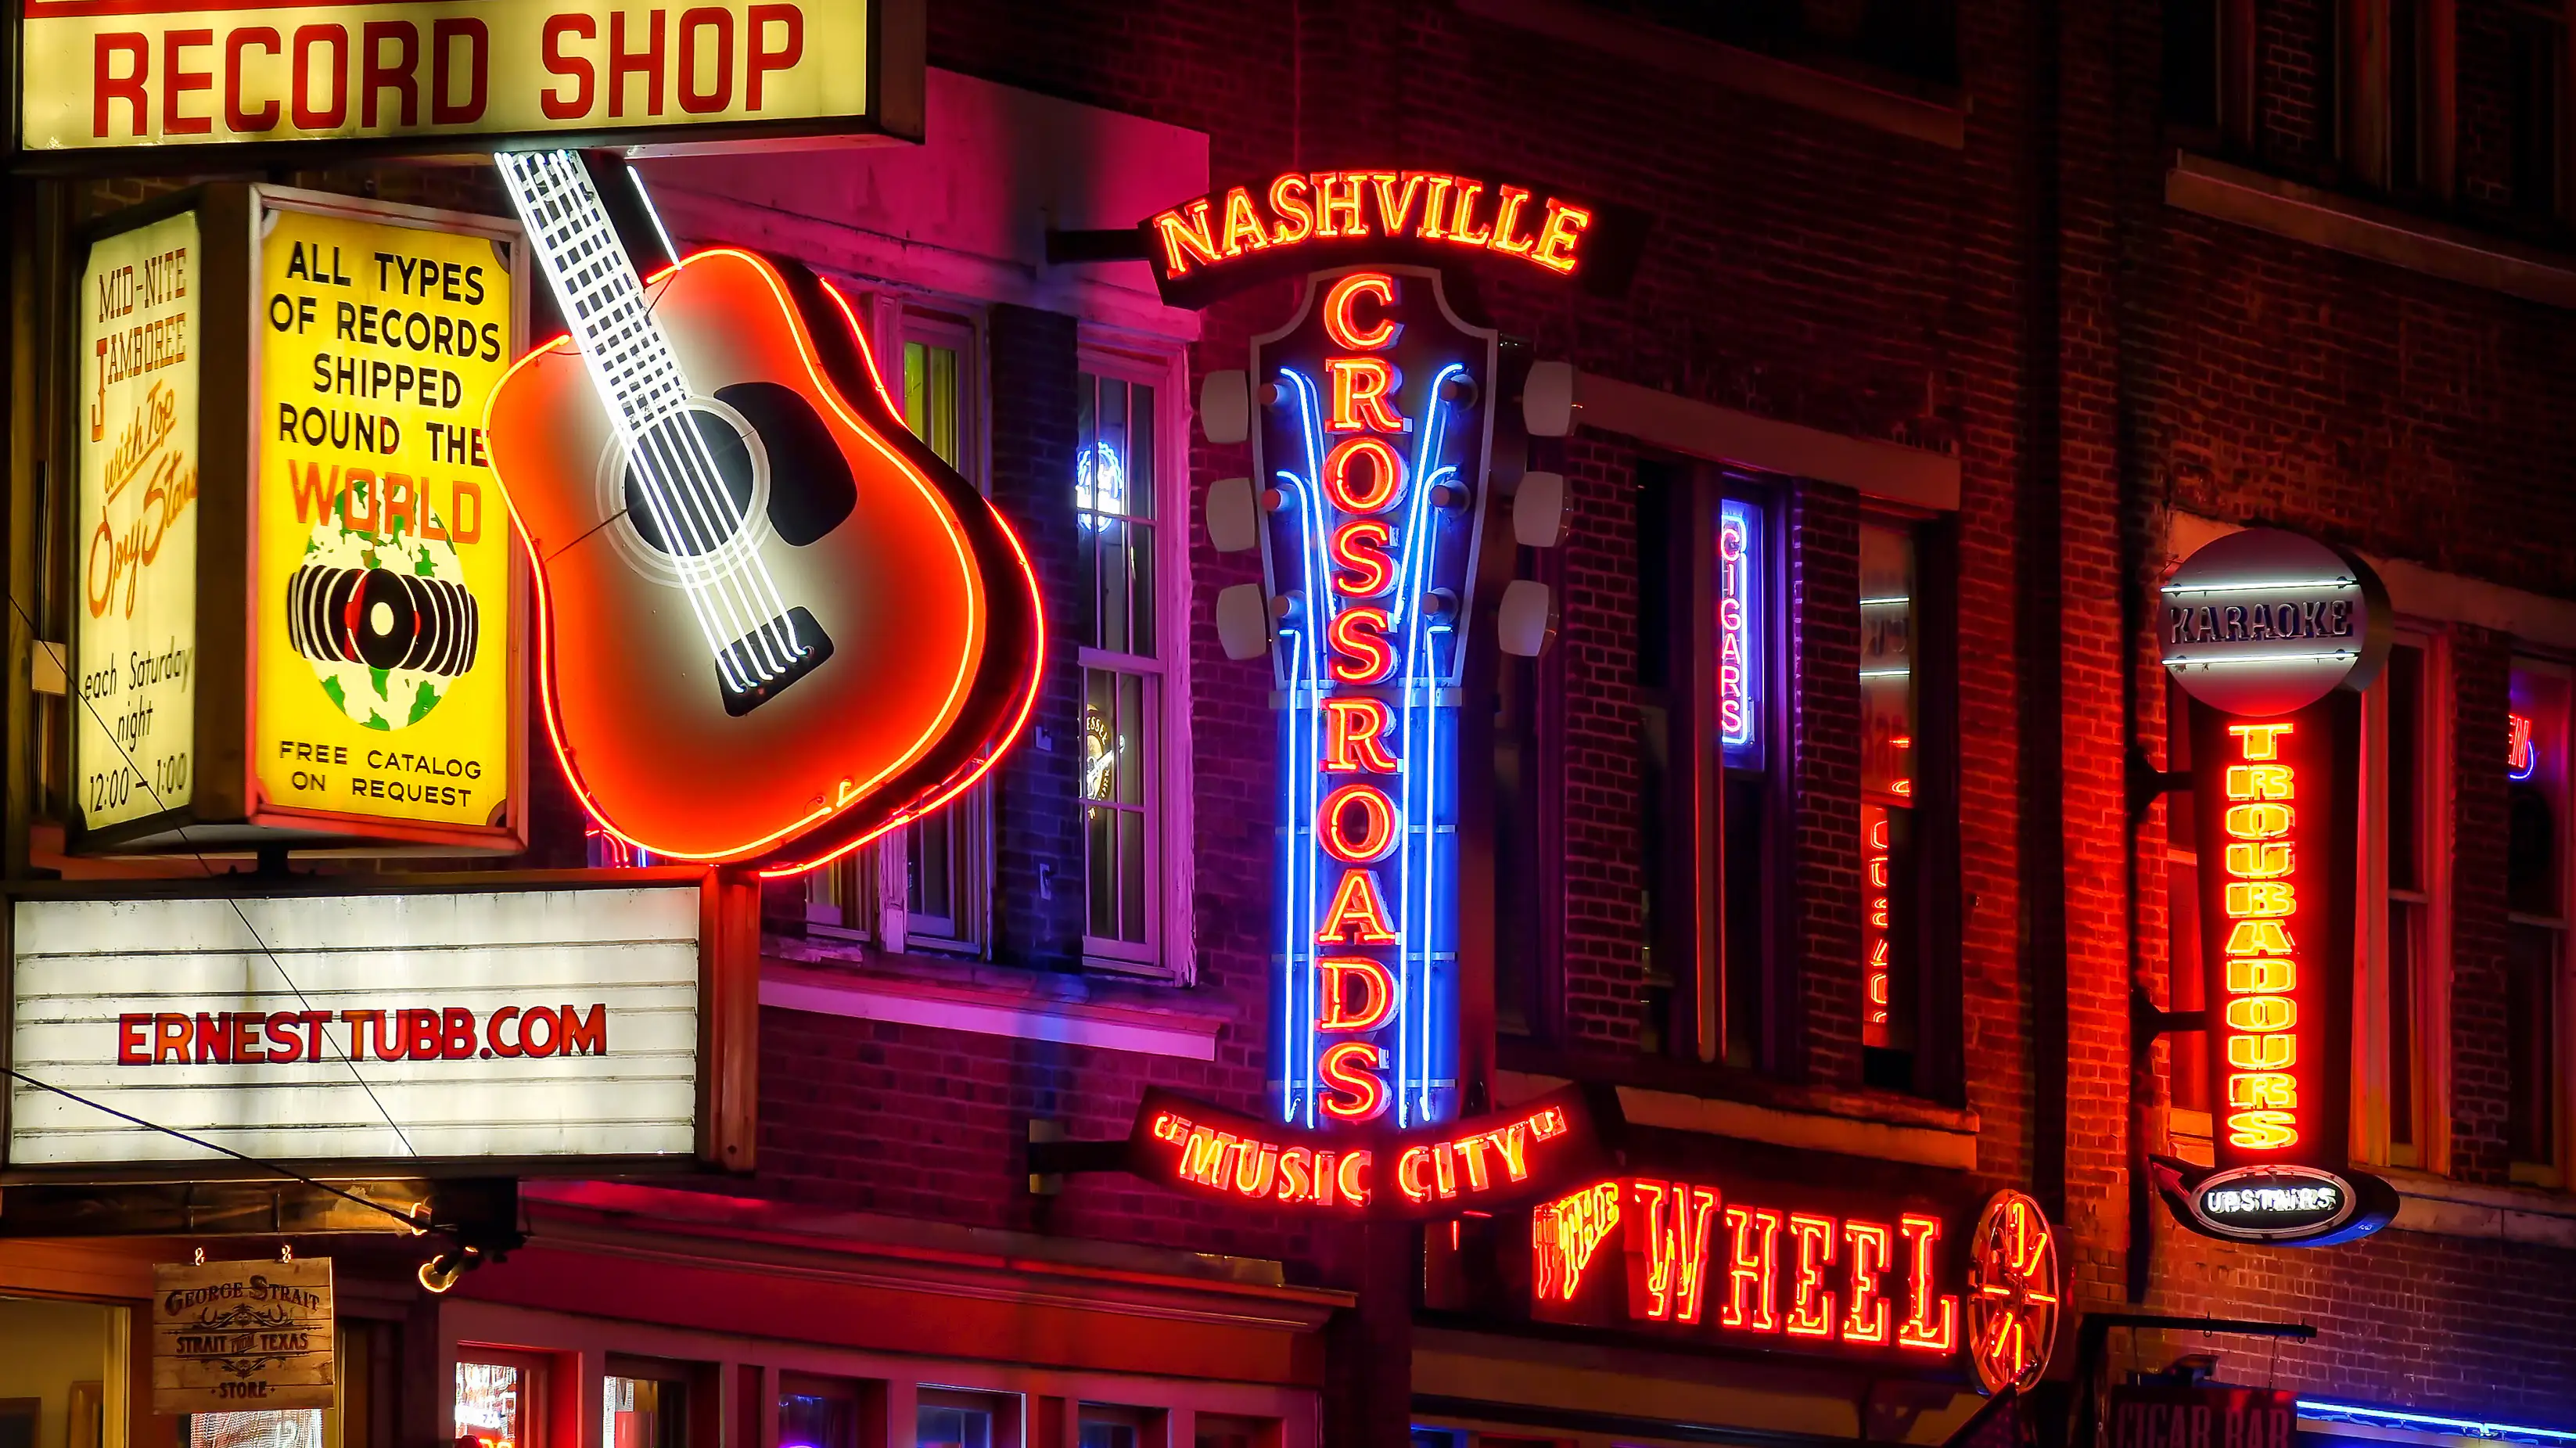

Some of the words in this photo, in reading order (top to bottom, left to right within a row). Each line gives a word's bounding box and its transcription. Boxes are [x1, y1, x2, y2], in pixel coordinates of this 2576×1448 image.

[93, 17, 489, 138] RECORD
[541, 5, 804, 120] SHOP
[1152, 169, 1590, 280] NASHVILLE
[98, 246, 188, 324] MID-NITE
[286, 240, 351, 287] ALL
[374, 251, 485, 306] TYPES
[270, 294, 317, 335] OF
[336, 300, 501, 362] RECORDS
[91, 311, 188, 443] JAMBOREE
[313, 352, 462, 409] SHIPPED
[104, 406, 144, 494] with
[146, 378, 177, 447] Top
[278, 402, 401, 455] ROUND
[426, 421, 489, 468] THE
[288, 459, 481, 545] WORLD
[87, 504, 142, 621] Opry
[1721, 528, 1741, 734] CIGARS
[2170, 600, 2353, 645] KARAOKE
[84, 652, 117, 701] each
[128, 635, 194, 693] Saturday
[1317, 271, 1412, 1122] CROSSROADS
[117, 695, 153, 753] night
[90, 767, 129, 814] 12:00
[156, 752, 187, 796] 1:00
[279, 740, 348, 764] FREE
[367, 749, 482, 780] CATALOG
[292, 771, 325, 791] ON
[352, 778, 472, 807] REQUEST
[2226, 722, 2298, 1149] TROUBADOURS
[118, 1011, 332, 1065] ERNEST
[340, 1004, 606, 1062] TUBB.COM
[164, 1281, 243, 1317] GEORGE
[249, 1274, 320, 1313] STRAIT
[1630, 1178, 1958, 1354] WHEEL
[176, 1335, 226, 1354] STRAIT
[260, 1332, 307, 1351] TEXAS
[218, 1381, 268, 1399] STORE
